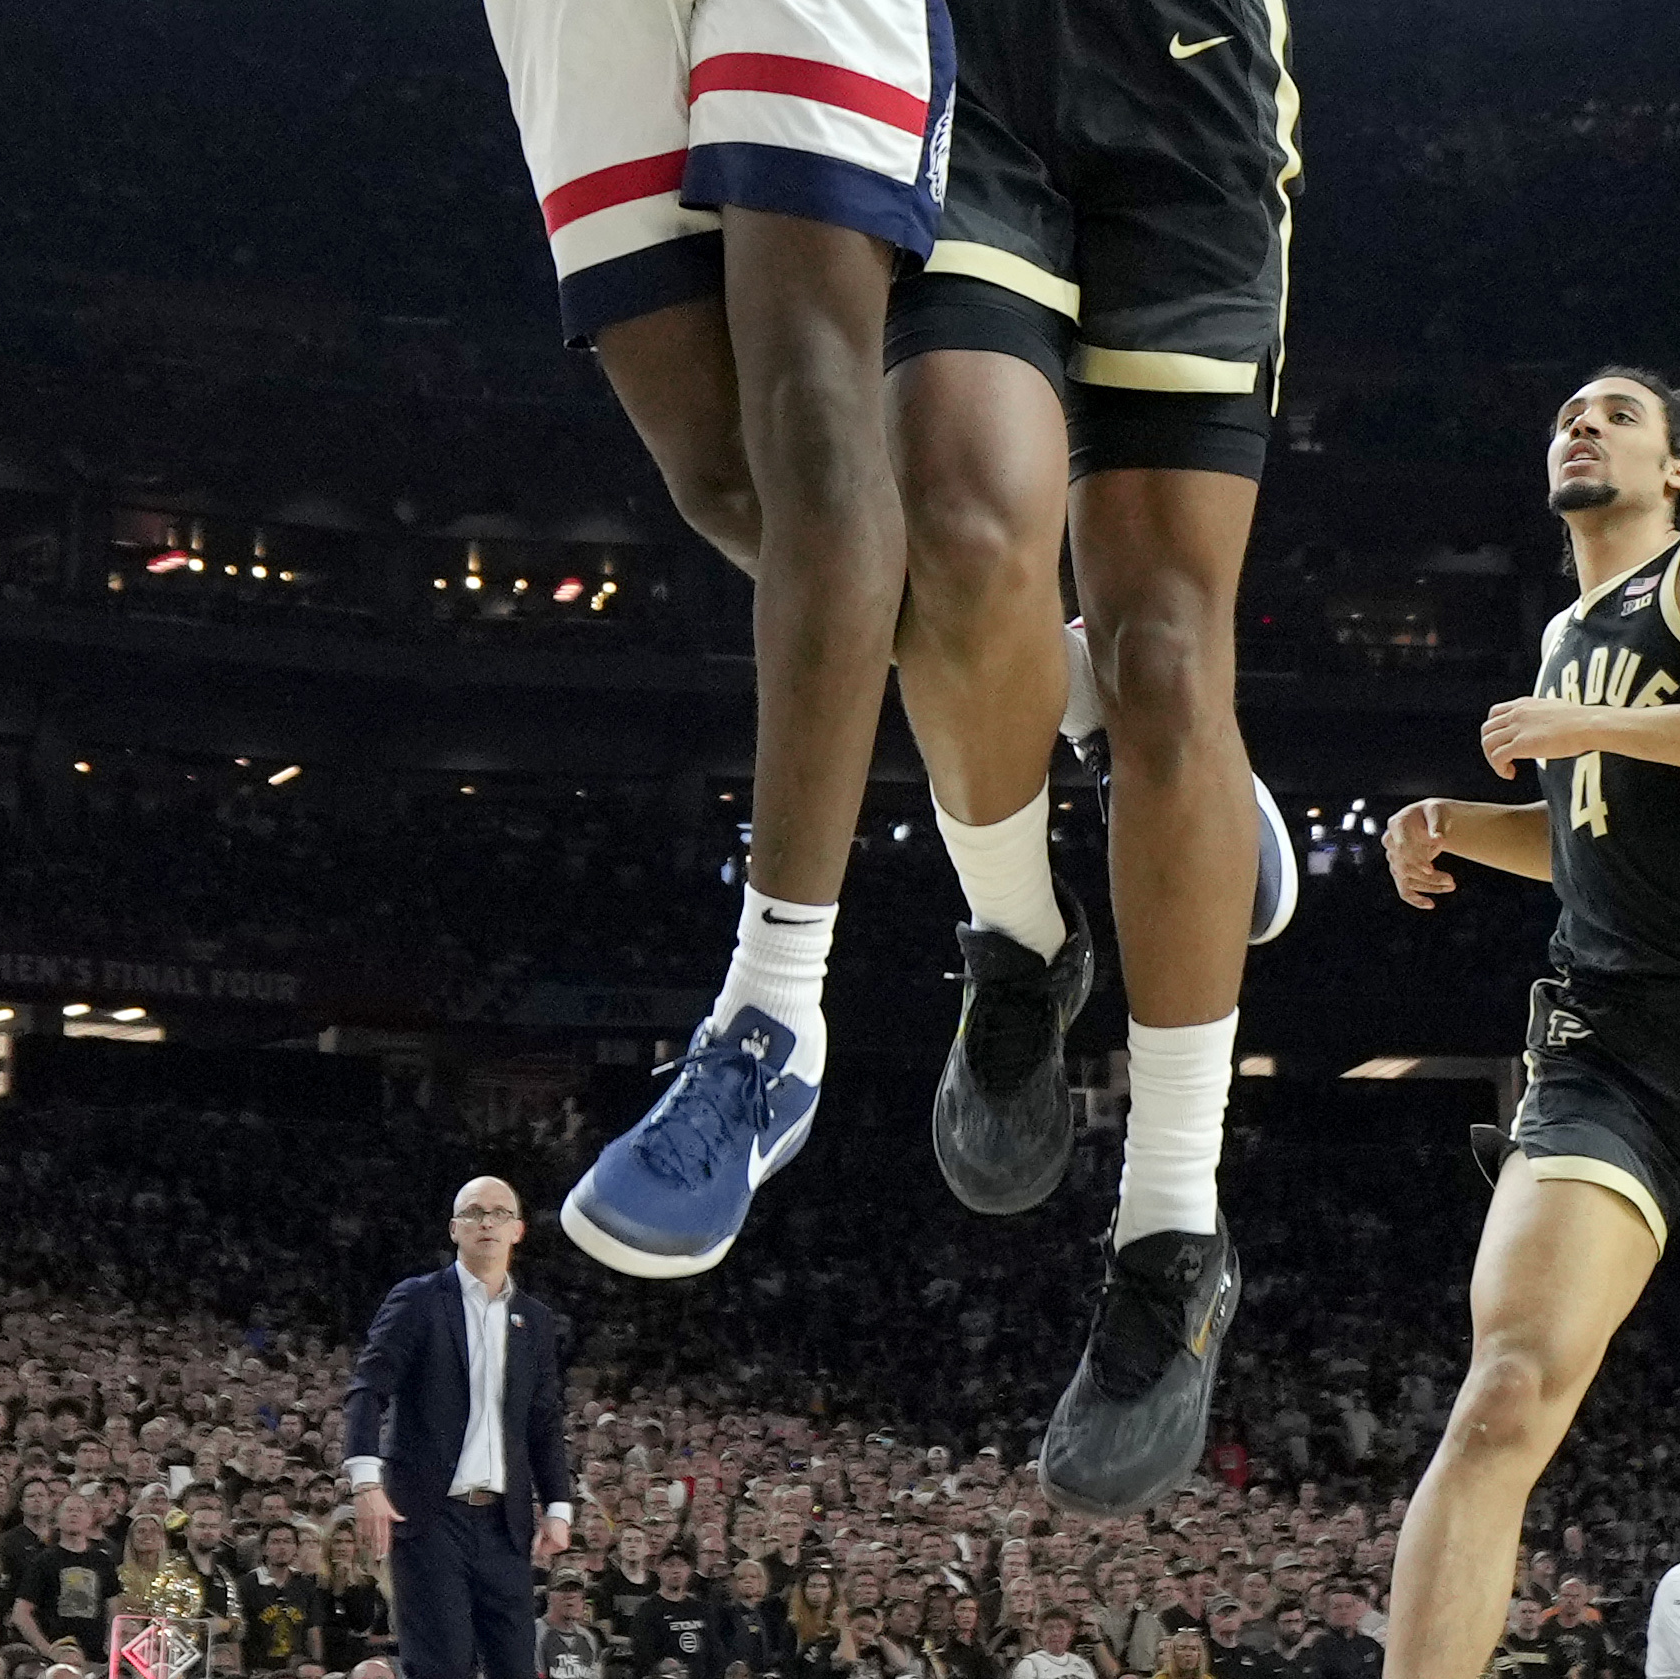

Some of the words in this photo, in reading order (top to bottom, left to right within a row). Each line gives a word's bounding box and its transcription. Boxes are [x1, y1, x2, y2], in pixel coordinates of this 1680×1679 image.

[1569, 749, 1609, 838] 4
[100, 960, 202, 997] FINAL
[210, 969, 298, 1004] FOUR
